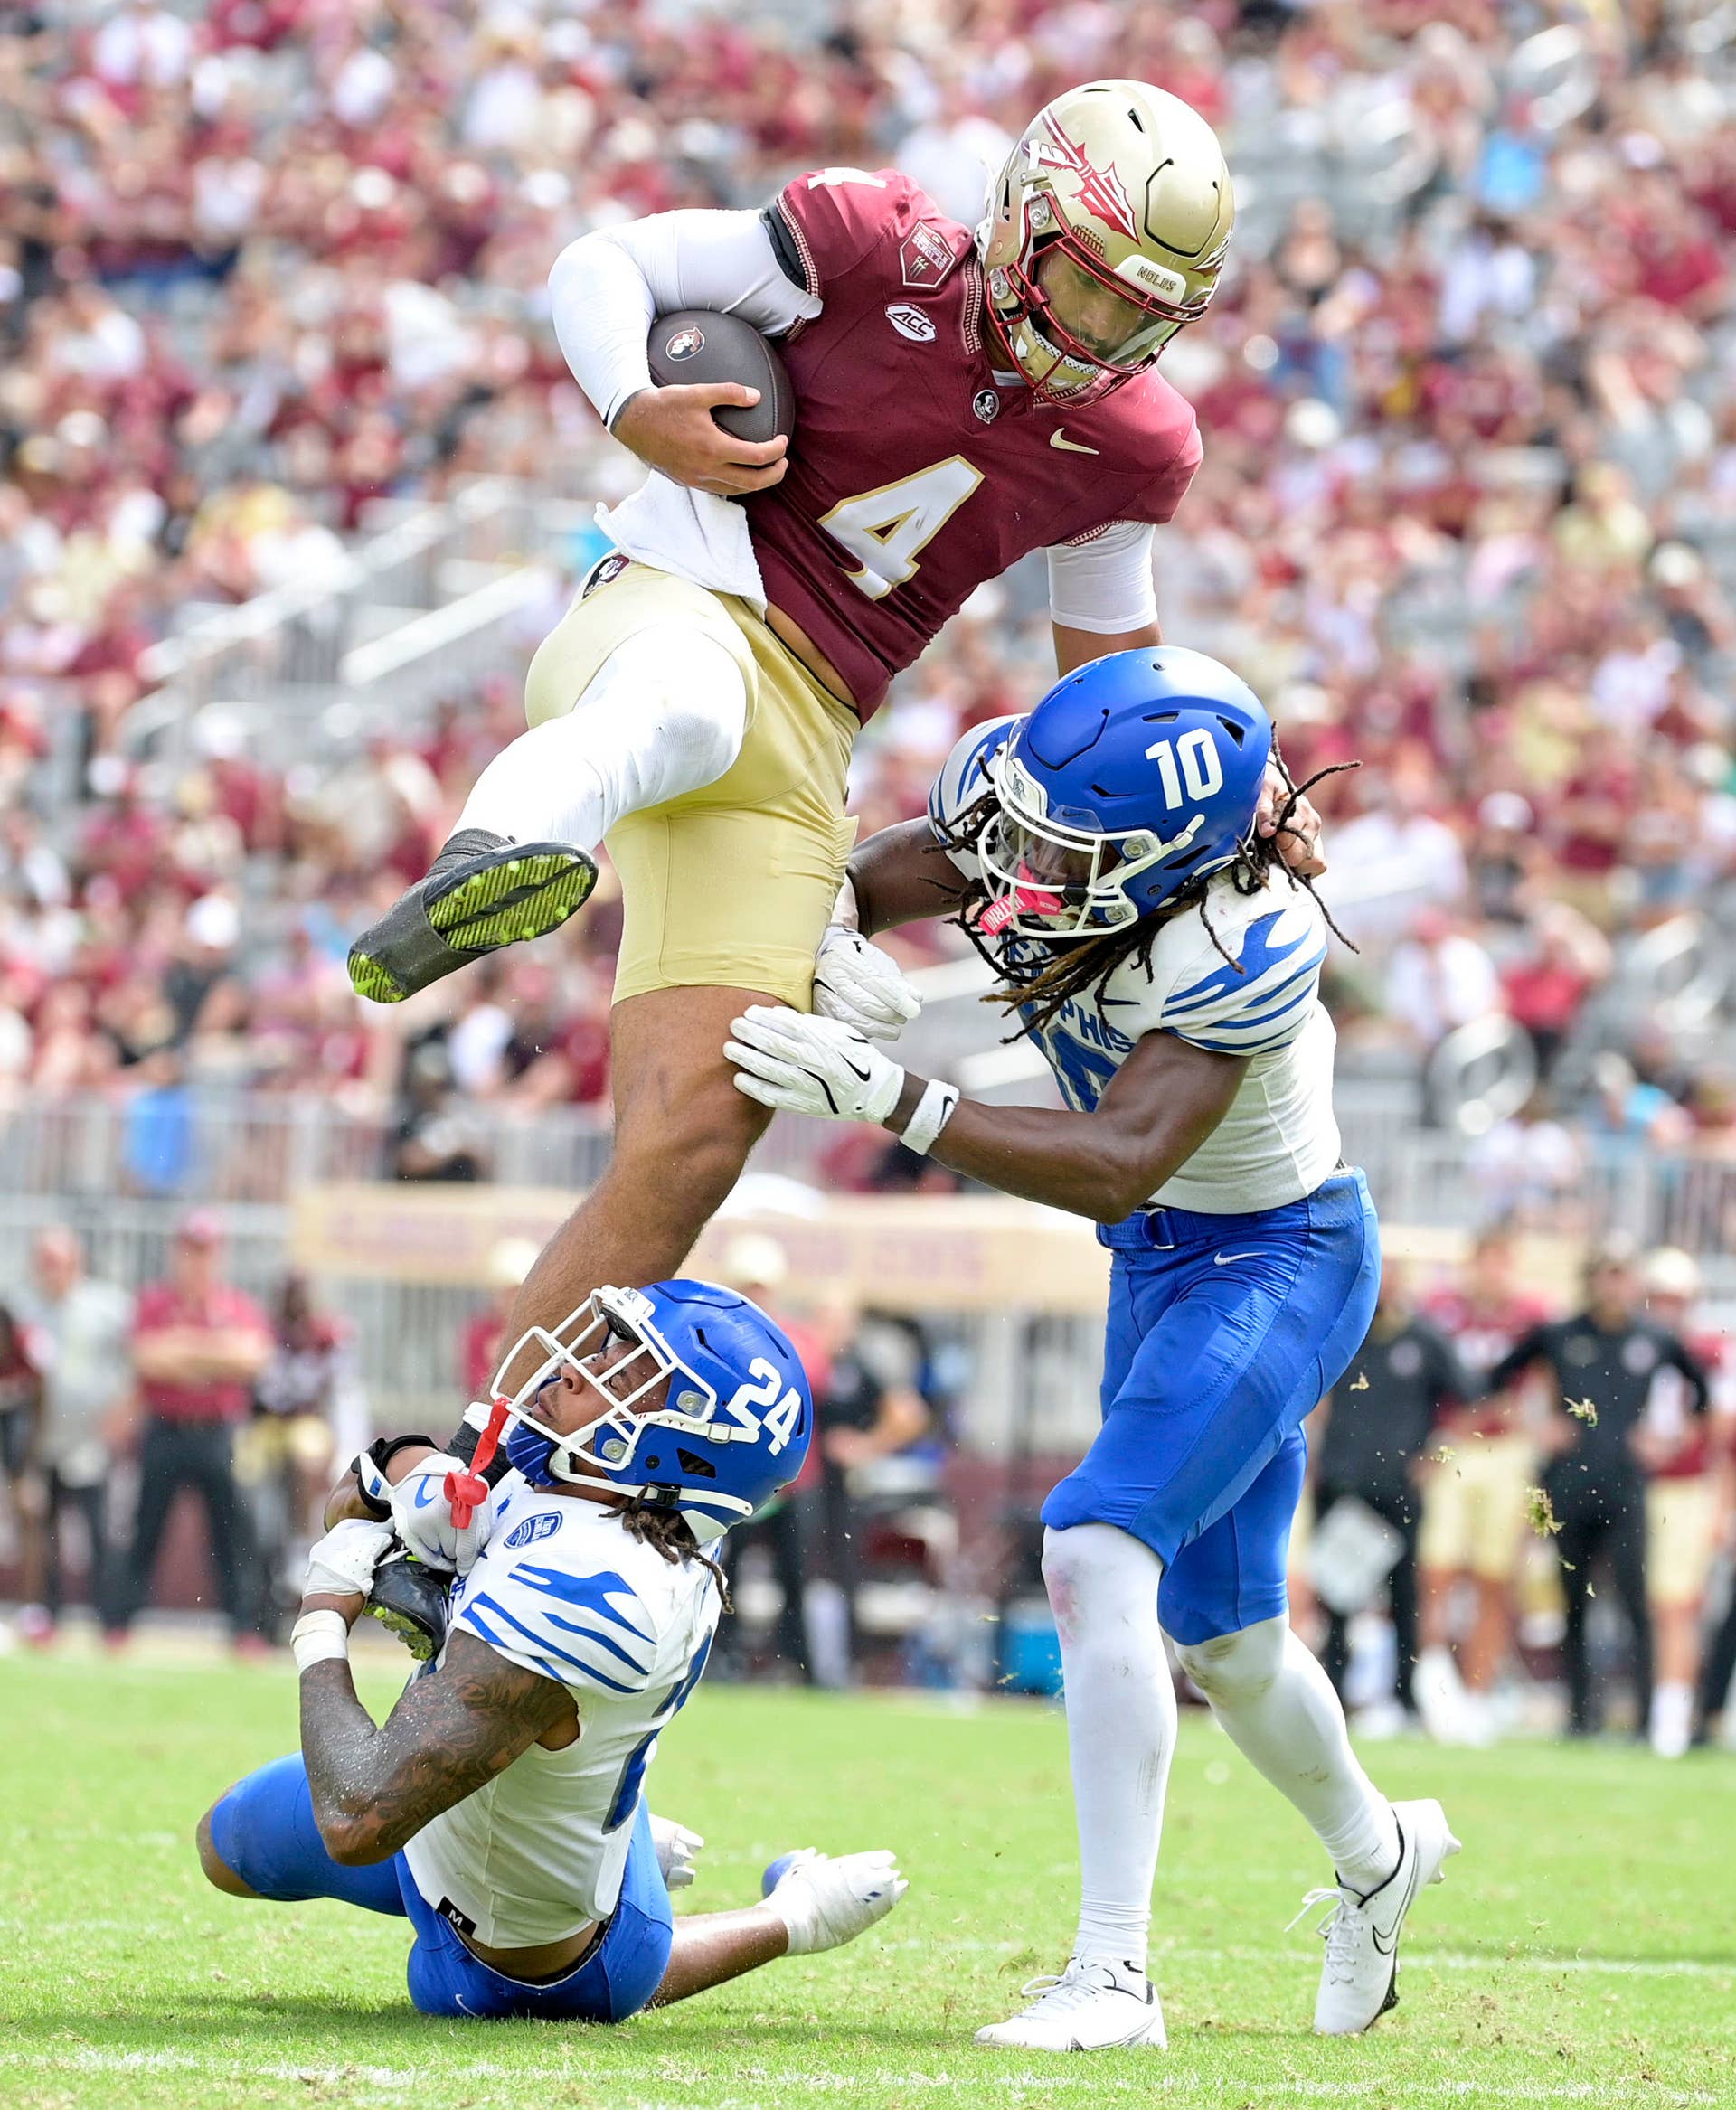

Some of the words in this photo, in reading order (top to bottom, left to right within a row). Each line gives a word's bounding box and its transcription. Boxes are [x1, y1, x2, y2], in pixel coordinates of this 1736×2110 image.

[1137, 266, 1177, 292] NOLES
[892, 312, 933, 334] ACC
[816, 453, 986, 601] 4
[1145, 728, 1223, 811] 10
[725, 1357, 802, 1457] 24
[448, 1909, 463, 1926] M
